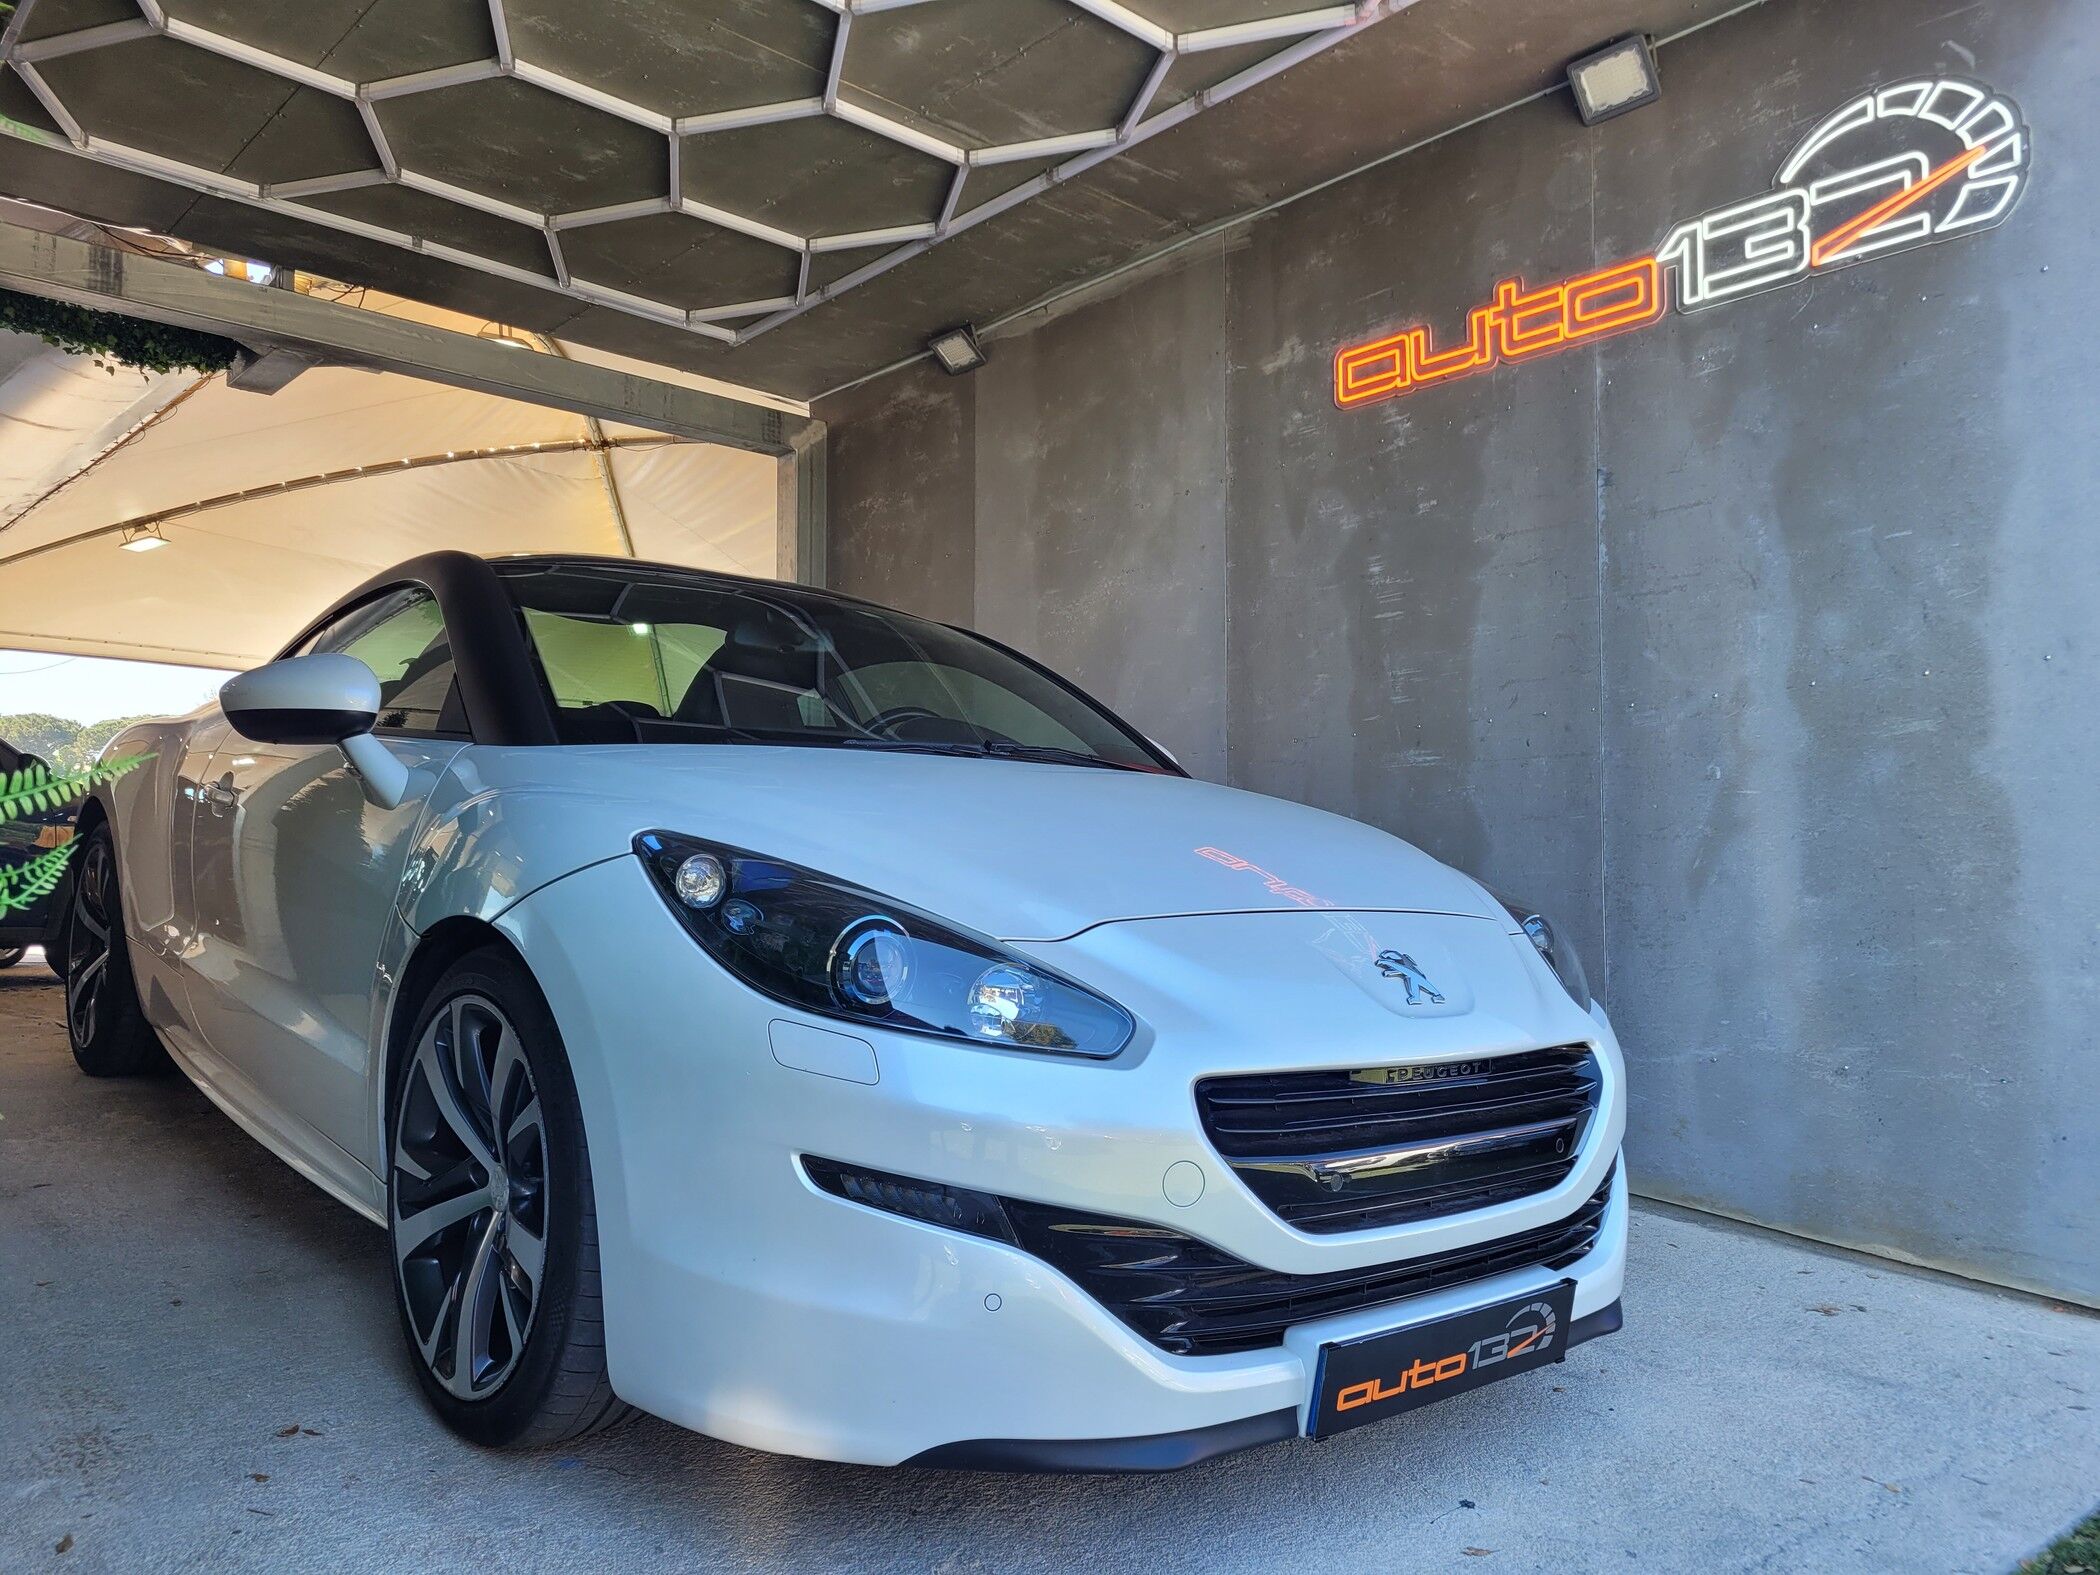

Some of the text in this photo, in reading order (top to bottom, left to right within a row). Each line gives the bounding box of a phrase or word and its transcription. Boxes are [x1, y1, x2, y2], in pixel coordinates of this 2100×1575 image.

[1336, 147, 1985, 404] auto132
[1397, 1061, 1482, 1082] PEUGEOT
[1336, 1322, 1551, 1412] auto132
